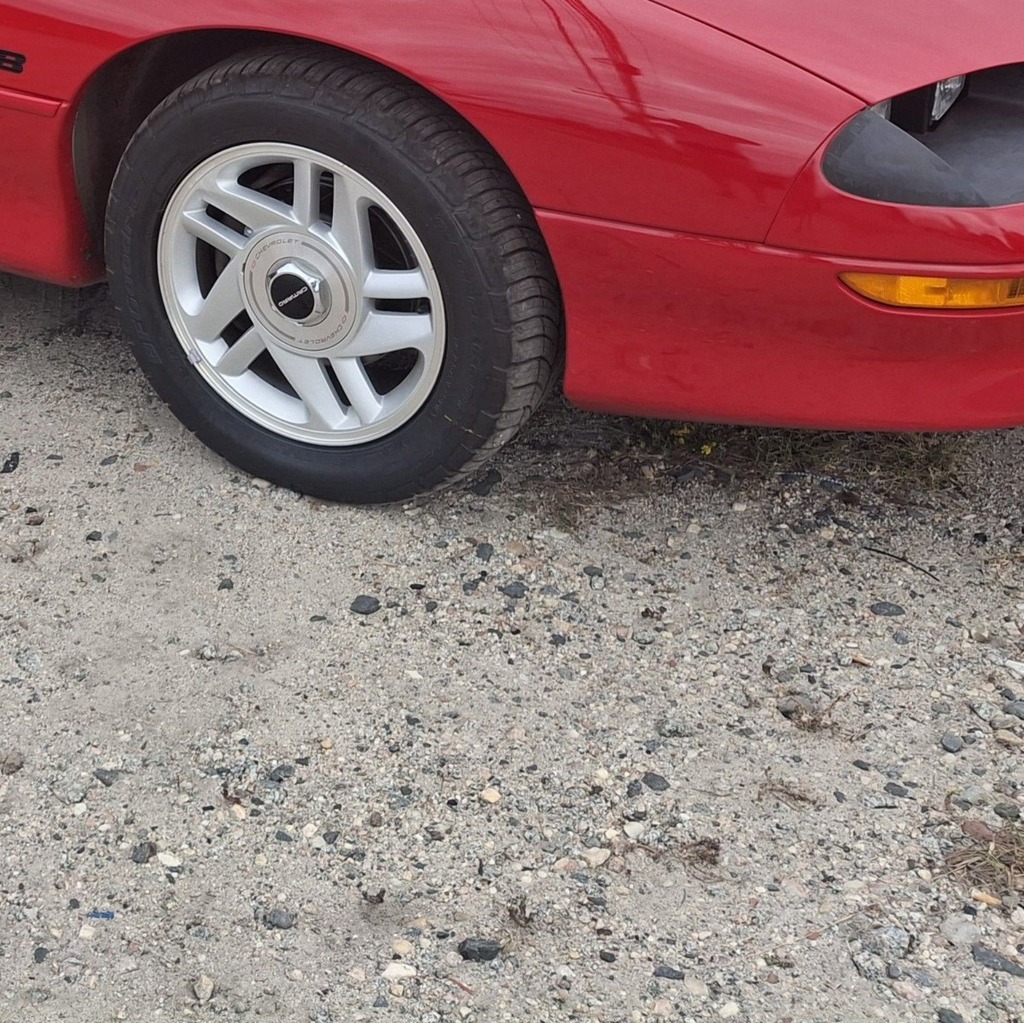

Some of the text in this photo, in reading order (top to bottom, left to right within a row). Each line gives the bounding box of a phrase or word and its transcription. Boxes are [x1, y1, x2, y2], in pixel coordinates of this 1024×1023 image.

[255, 238, 299, 260] CHEVROLET
[277, 286, 308, 307] CAMARO
[298, 324, 343, 344] CHEVROLET
